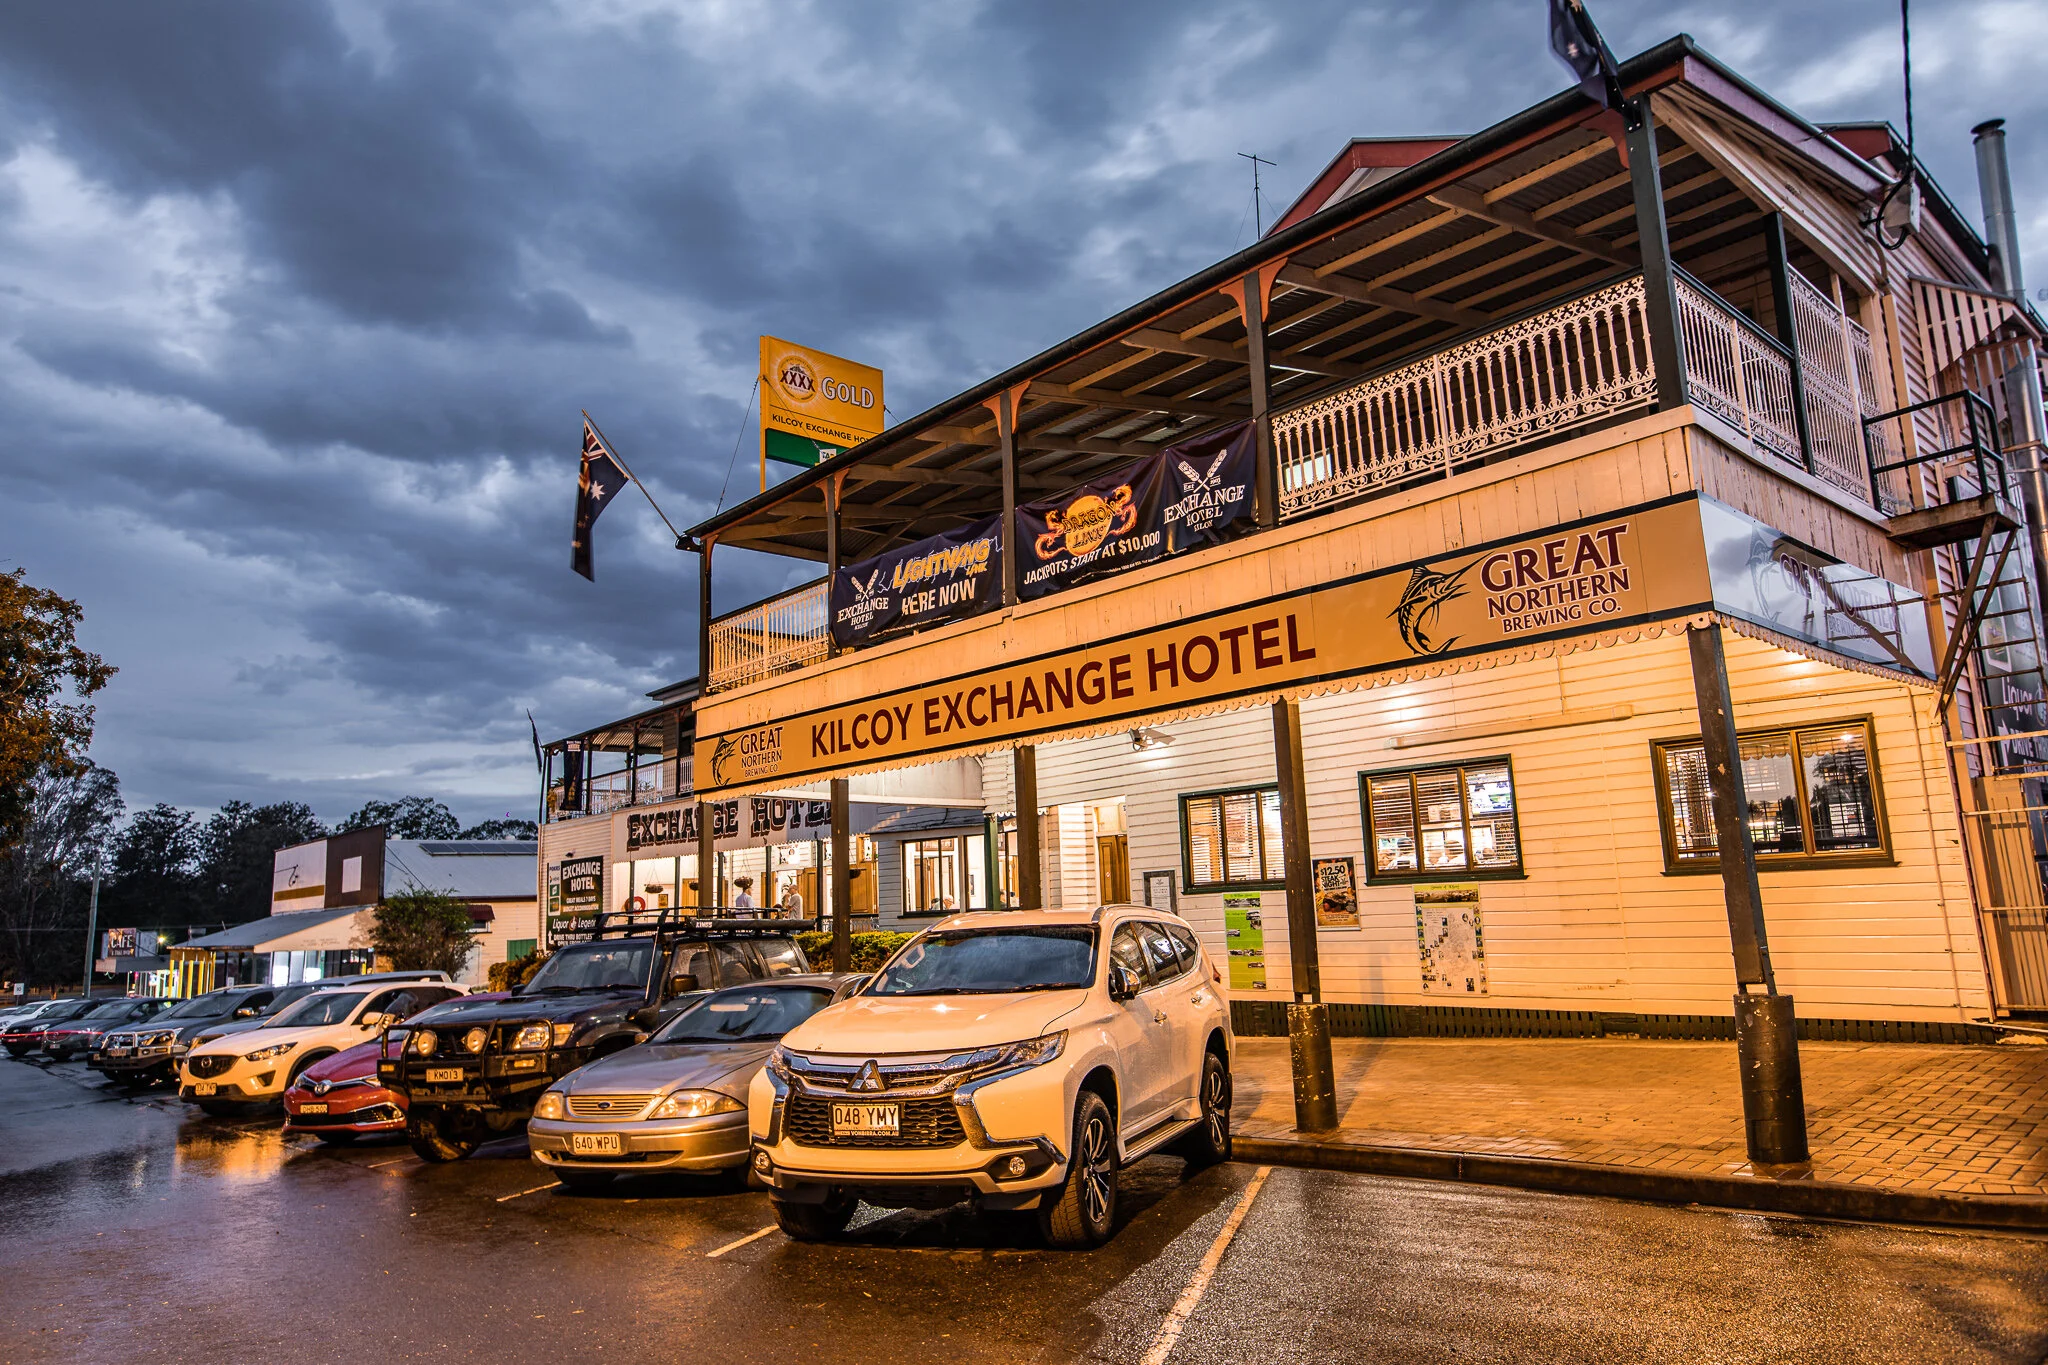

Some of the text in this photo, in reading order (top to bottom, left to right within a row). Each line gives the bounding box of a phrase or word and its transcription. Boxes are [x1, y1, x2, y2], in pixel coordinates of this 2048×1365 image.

[780, 369, 816, 392] XXXX
[821, 376, 875, 409] GOLD
[772, 413, 803, 428] KILCOY
[805, 424, 852, 441] EXCHANGE
[1061, 500, 1117, 534] DRAGON
[1163, 485, 1246, 525] EXCHANGE
[1186, 506, 1223, 527] HOTEL
[1072, 525, 1107, 548] LINK
[893, 538, 991, 593] LIGHTNING
[966, 561, 988, 576] LINK
[1024, 559, 1069, 585] JACKPOTS
[1070, 548, 1101, 569] START
[1101, 542, 1116, 559] AT
[1118, 530, 1161, 556] $10,000
[1480, 522, 1629, 593] GREAT
[1780, 552, 1829, 607] GREAT
[902, 577, 977, 616] HERE NOW
[1487, 567, 1630, 620] NORTHERN
[836, 596, 889, 623] EXCHANGE
[850, 611, 874, 626] HOTEL
[1502, 598, 1622, 634] BREWING CO.
[812, 614, 1317, 758] KILCOY EXCHANGE HOTEL
[740, 726, 784, 755] GREAT
[741, 749, 783, 769] NORTHERN
[744, 765, 768, 778] BREWING
[627, 800, 739, 852] EXCHAGE
[562, 862, 601, 880] EXCHANGE
[1320, 865, 1346, 876] $12.50
[1321, 874, 1340, 882] STEAK
[571, 877, 595, 892] HOTEL
[552, 918, 569, 932] Liquor
[111, 934, 133, 948] CAFE
